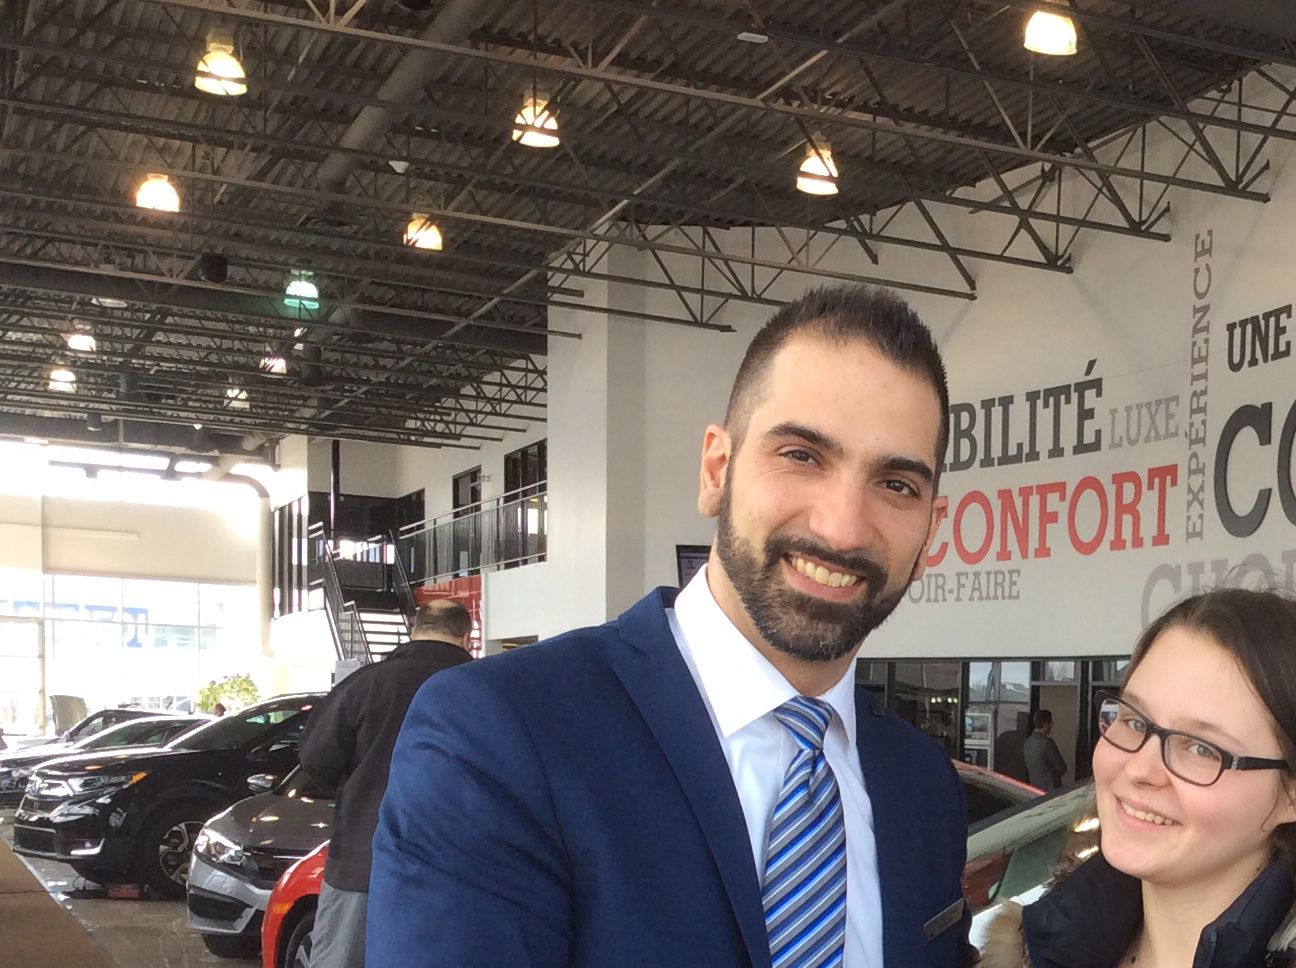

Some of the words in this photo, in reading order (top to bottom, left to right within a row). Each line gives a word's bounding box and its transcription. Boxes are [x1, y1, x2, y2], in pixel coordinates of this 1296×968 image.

[1226, 304, 1291, 372] UNE
[941, 359, 1102, 472] BILITÉ
[1108, 395, 1180, 449] LUXE
[1185, 228, 1213, 542] EXPÉRIENCE
